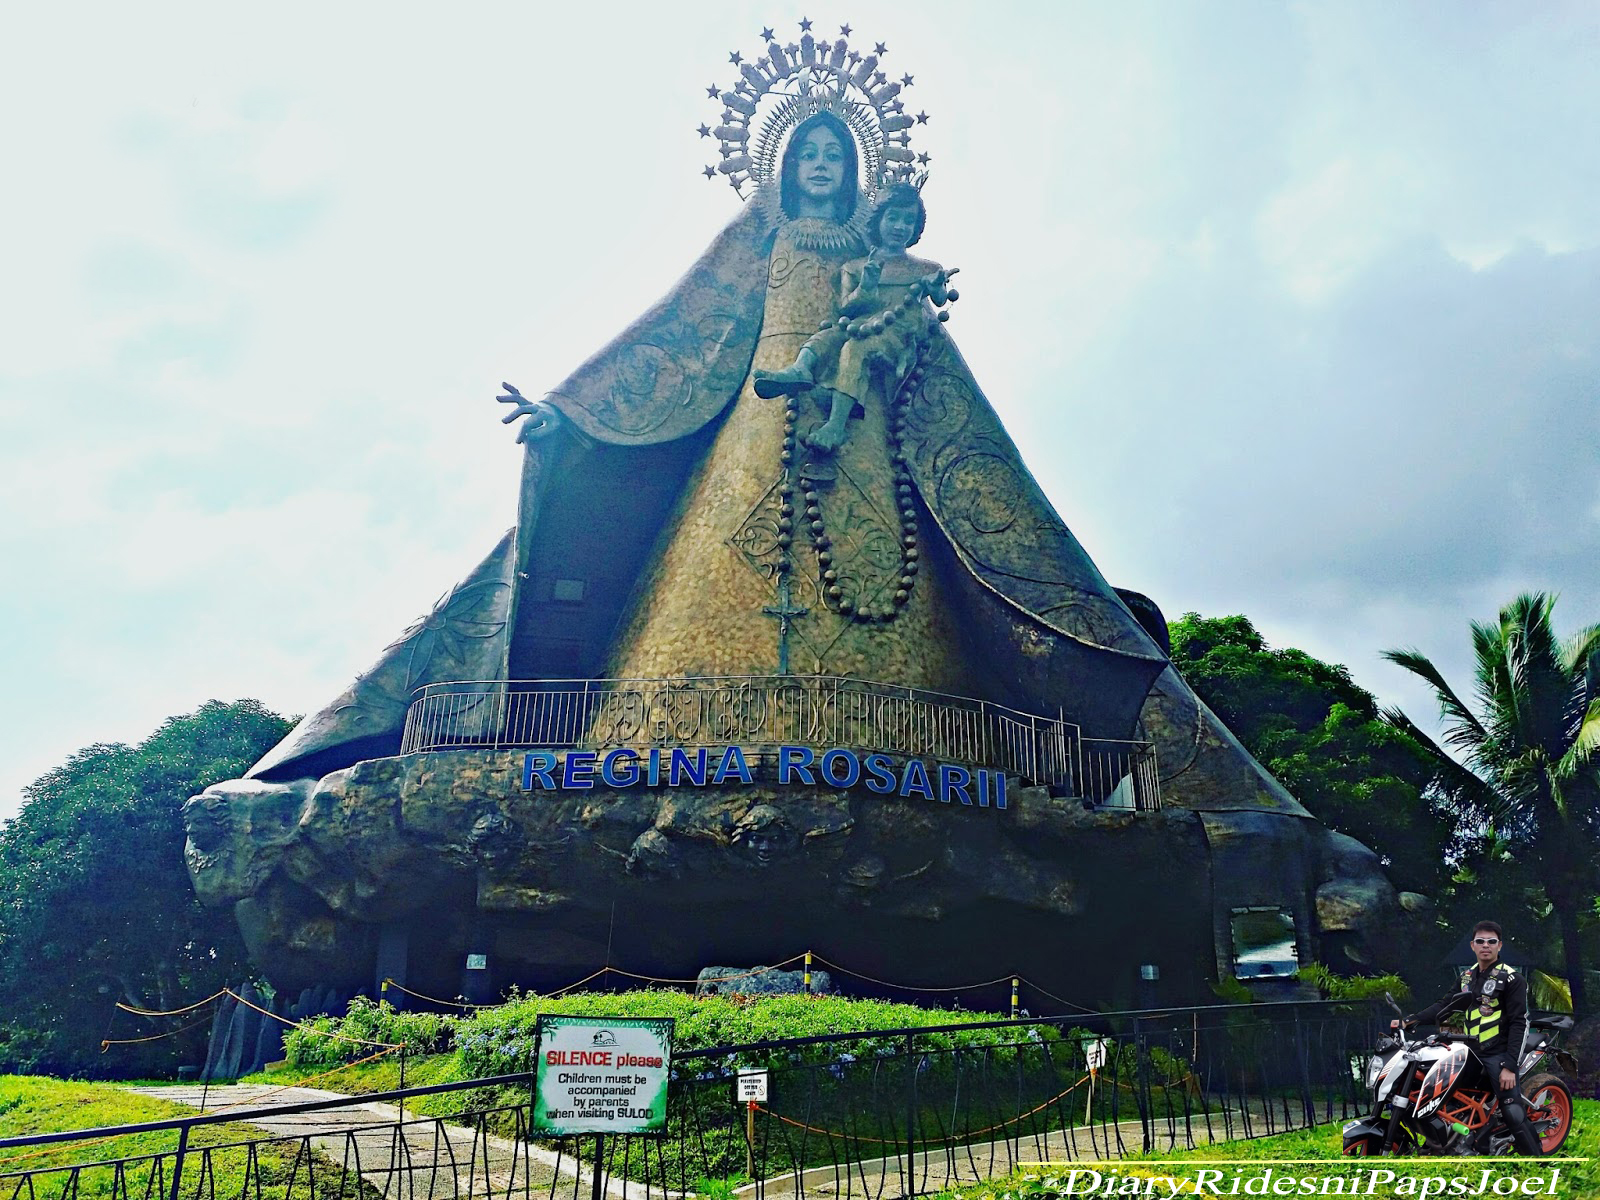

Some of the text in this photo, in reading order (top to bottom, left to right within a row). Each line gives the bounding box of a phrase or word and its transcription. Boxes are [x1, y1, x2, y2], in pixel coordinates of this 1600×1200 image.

[521, 745, 1008, 810] REGINA ROSARII
[546, 1050, 663, 1069] SILENCE please
[558, 1073, 647, 1085] Children must be
[567, 1085, 637, 1097] accompanied
[573, 1097, 630, 1109] by parents
[546, 1107, 654, 1120] when visiting SULOD
